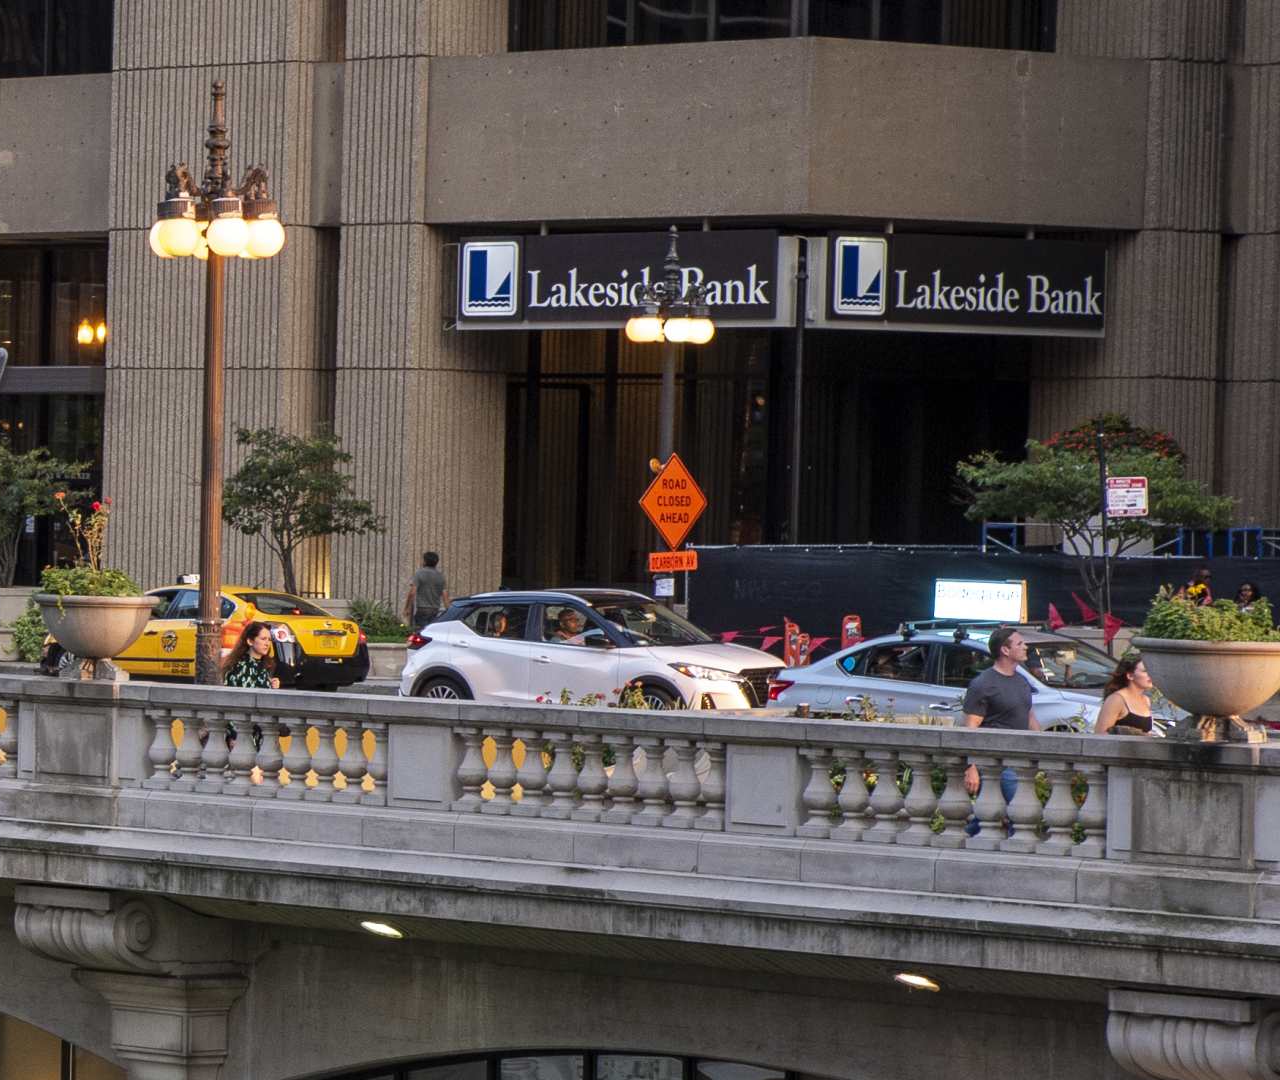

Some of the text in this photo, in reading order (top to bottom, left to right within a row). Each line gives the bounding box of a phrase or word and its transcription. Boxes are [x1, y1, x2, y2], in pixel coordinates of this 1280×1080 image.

[527, 265, 665, 308] Lakeside
[895, 269, 1103, 315] Lakeside Bank
[662, 479, 687, 490] ROAD
[657, 496, 692, 507] CLOSED
[660, 513, 689, 523] AHEAD
[651, 556, 695, 570] DEARBORN AV
